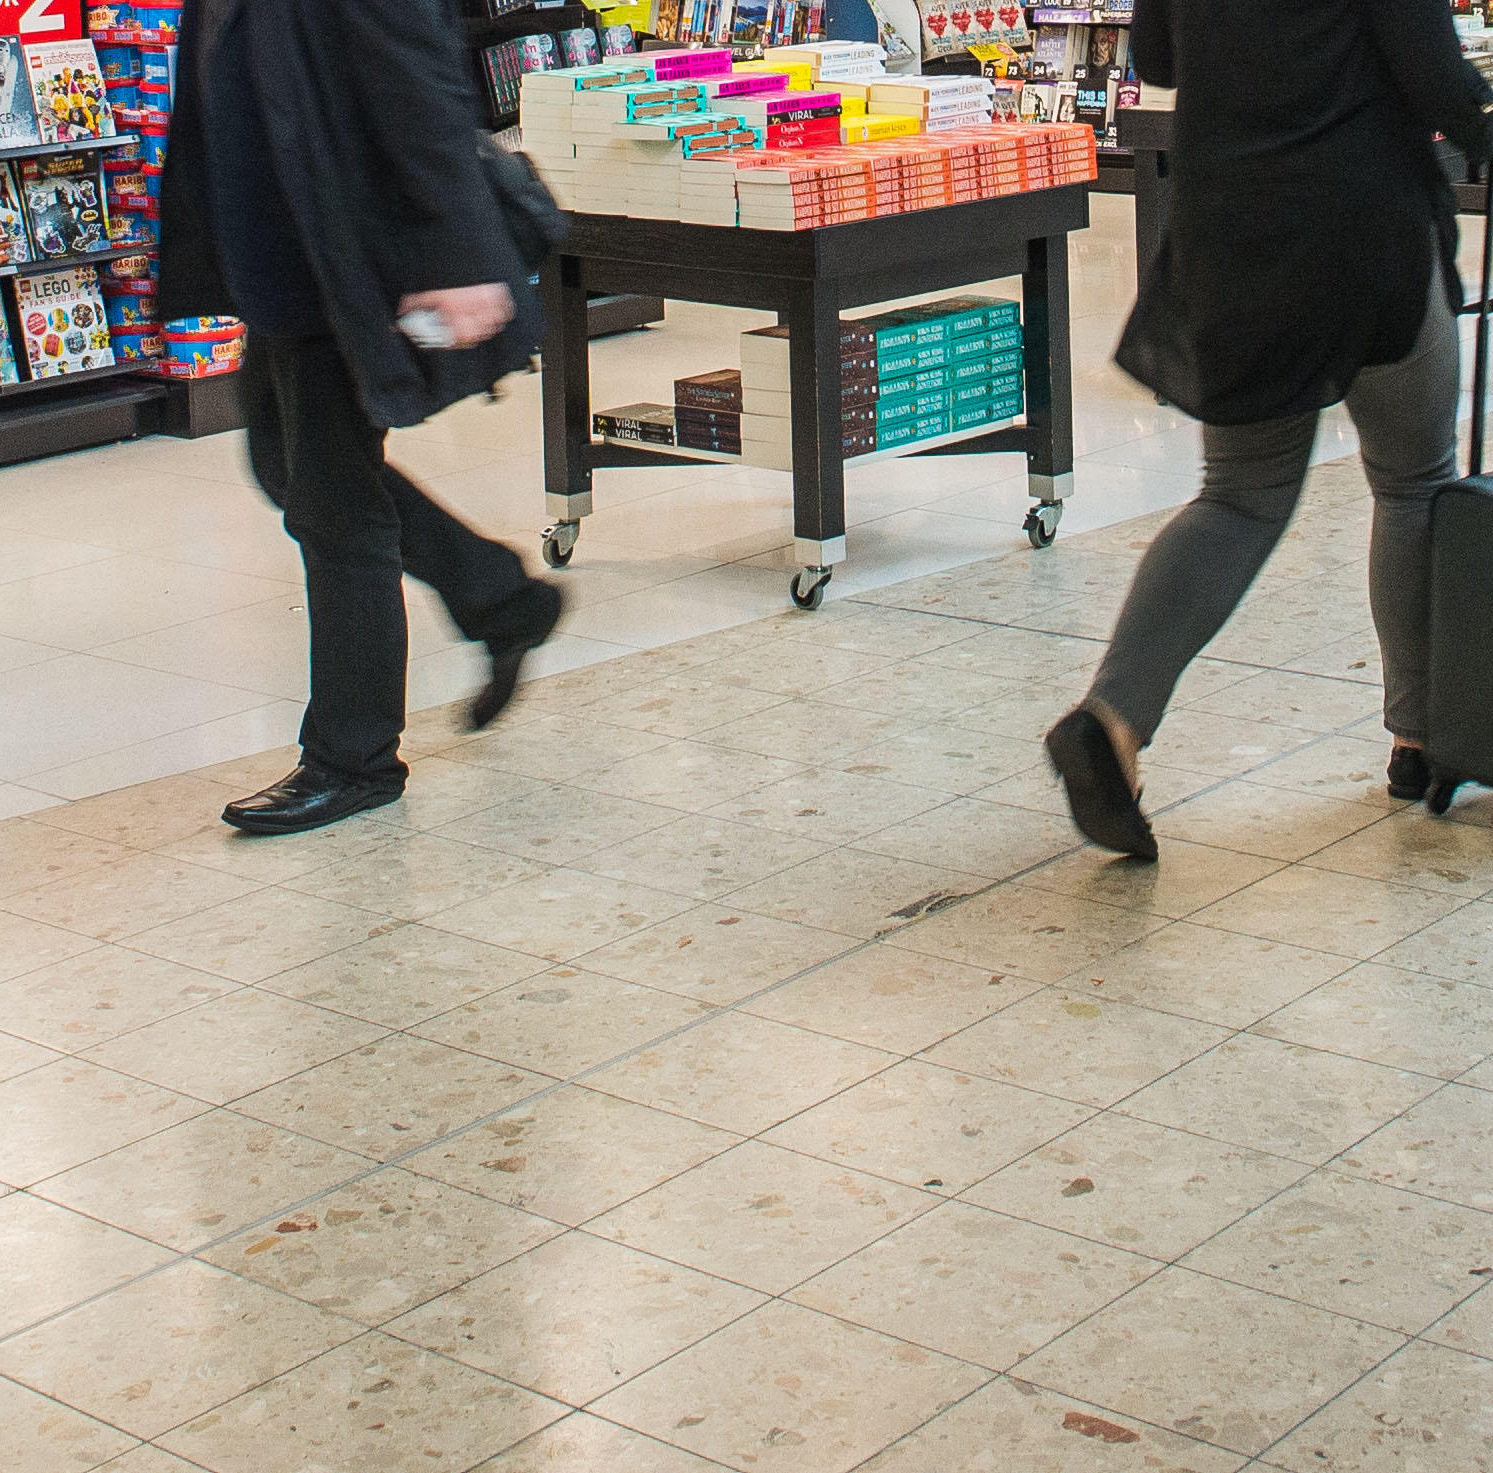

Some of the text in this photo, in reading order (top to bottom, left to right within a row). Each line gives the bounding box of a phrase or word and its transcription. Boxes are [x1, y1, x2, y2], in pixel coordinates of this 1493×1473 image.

[851, 50, 875, 59] LEADING
[523, 54, 555, 69] dark
[984, 68, 994, 76] 72
[1009, 66, 1017, 75] 73
[958, 84, 983, 95] LEADING
[1078, 90, 1106, 100] THIS IS
[788, 110, 814, 121] VIRAL
[112, 257, 148, 269] HARIBO
[34, 279, 70, 298] LEGO
[30, 292, 81, 307] FAN'S GUIDE
[615, 418, 642, 431] VIRAL
[615, 429, 642, 441] VIRAL
